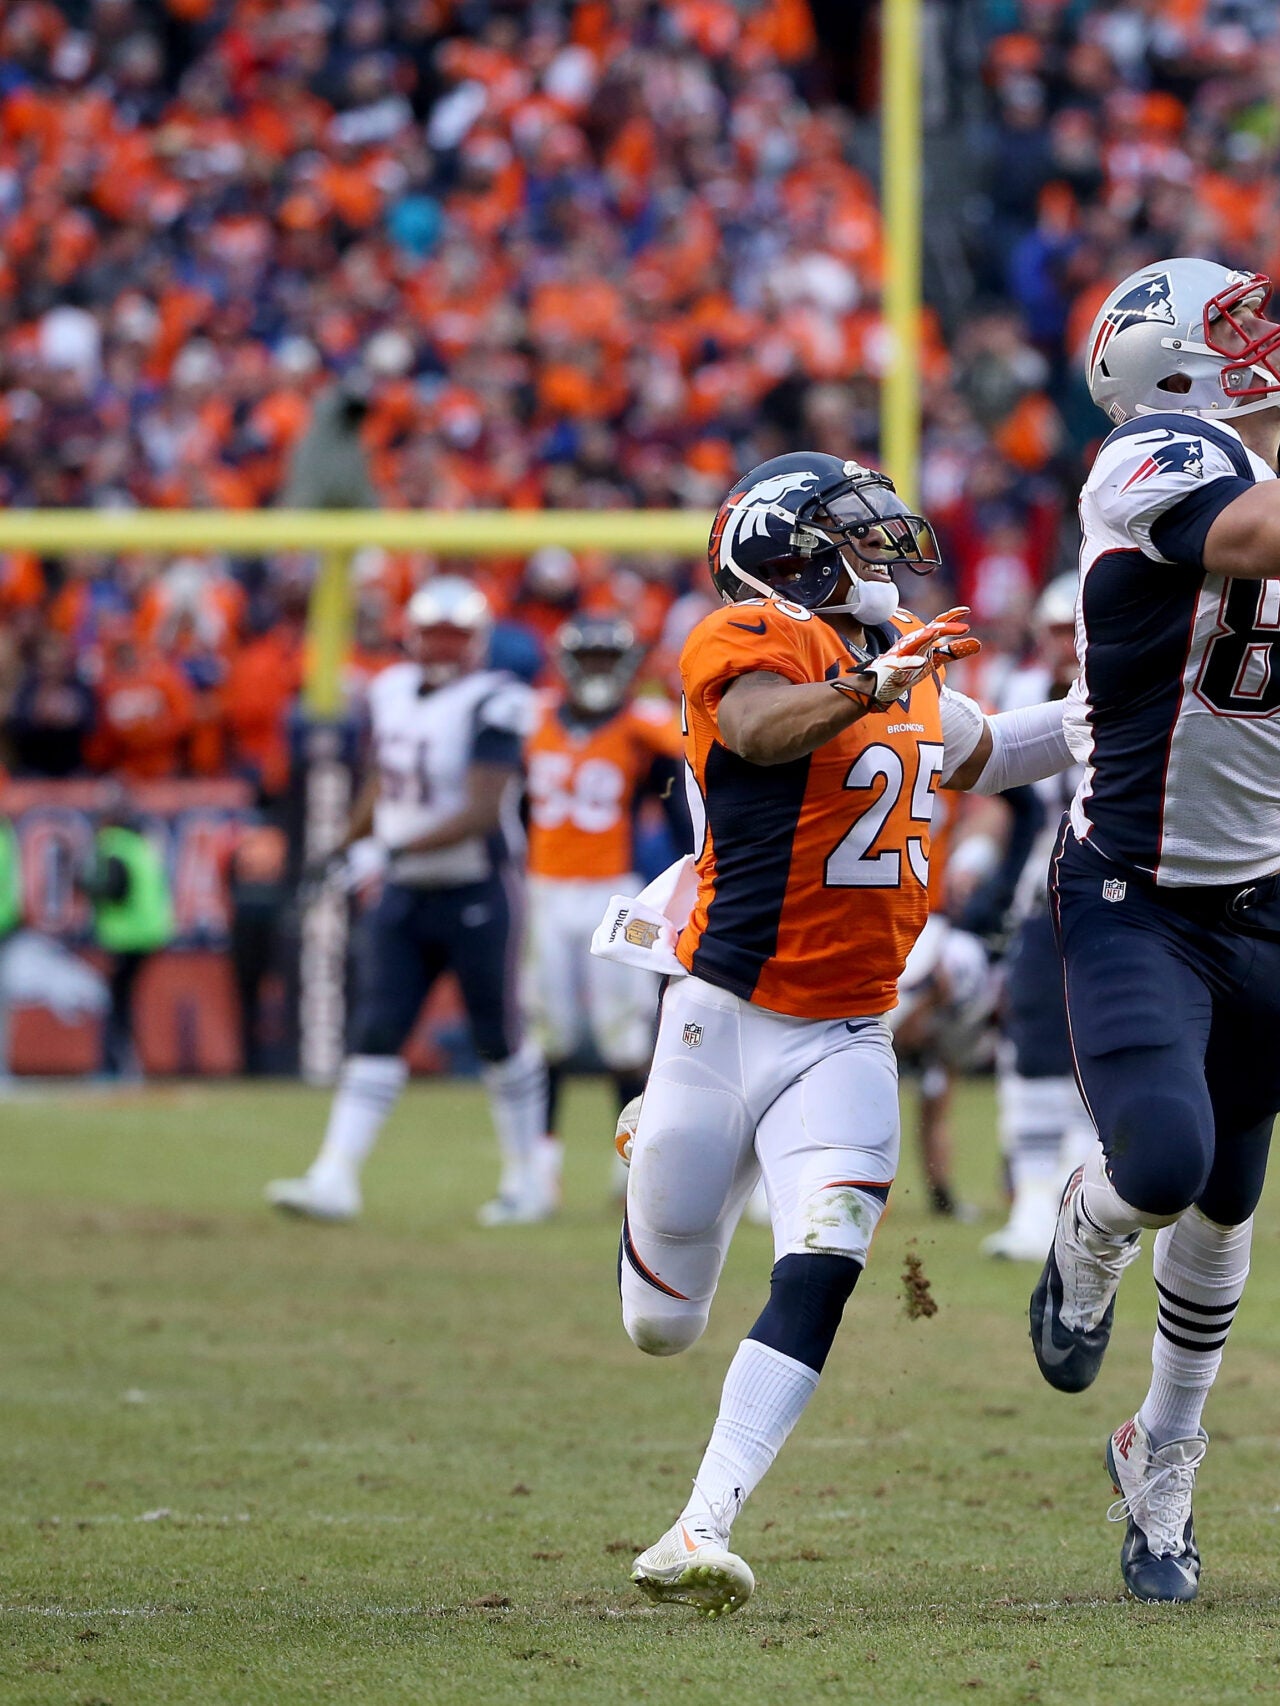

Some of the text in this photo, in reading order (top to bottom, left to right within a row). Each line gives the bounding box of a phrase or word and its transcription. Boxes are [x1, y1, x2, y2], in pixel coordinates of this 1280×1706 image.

[887, 723, 925, 734] BRONCOS
[822, 740, 945, 890] 25
[608, 908, 630, 943] Wilson
